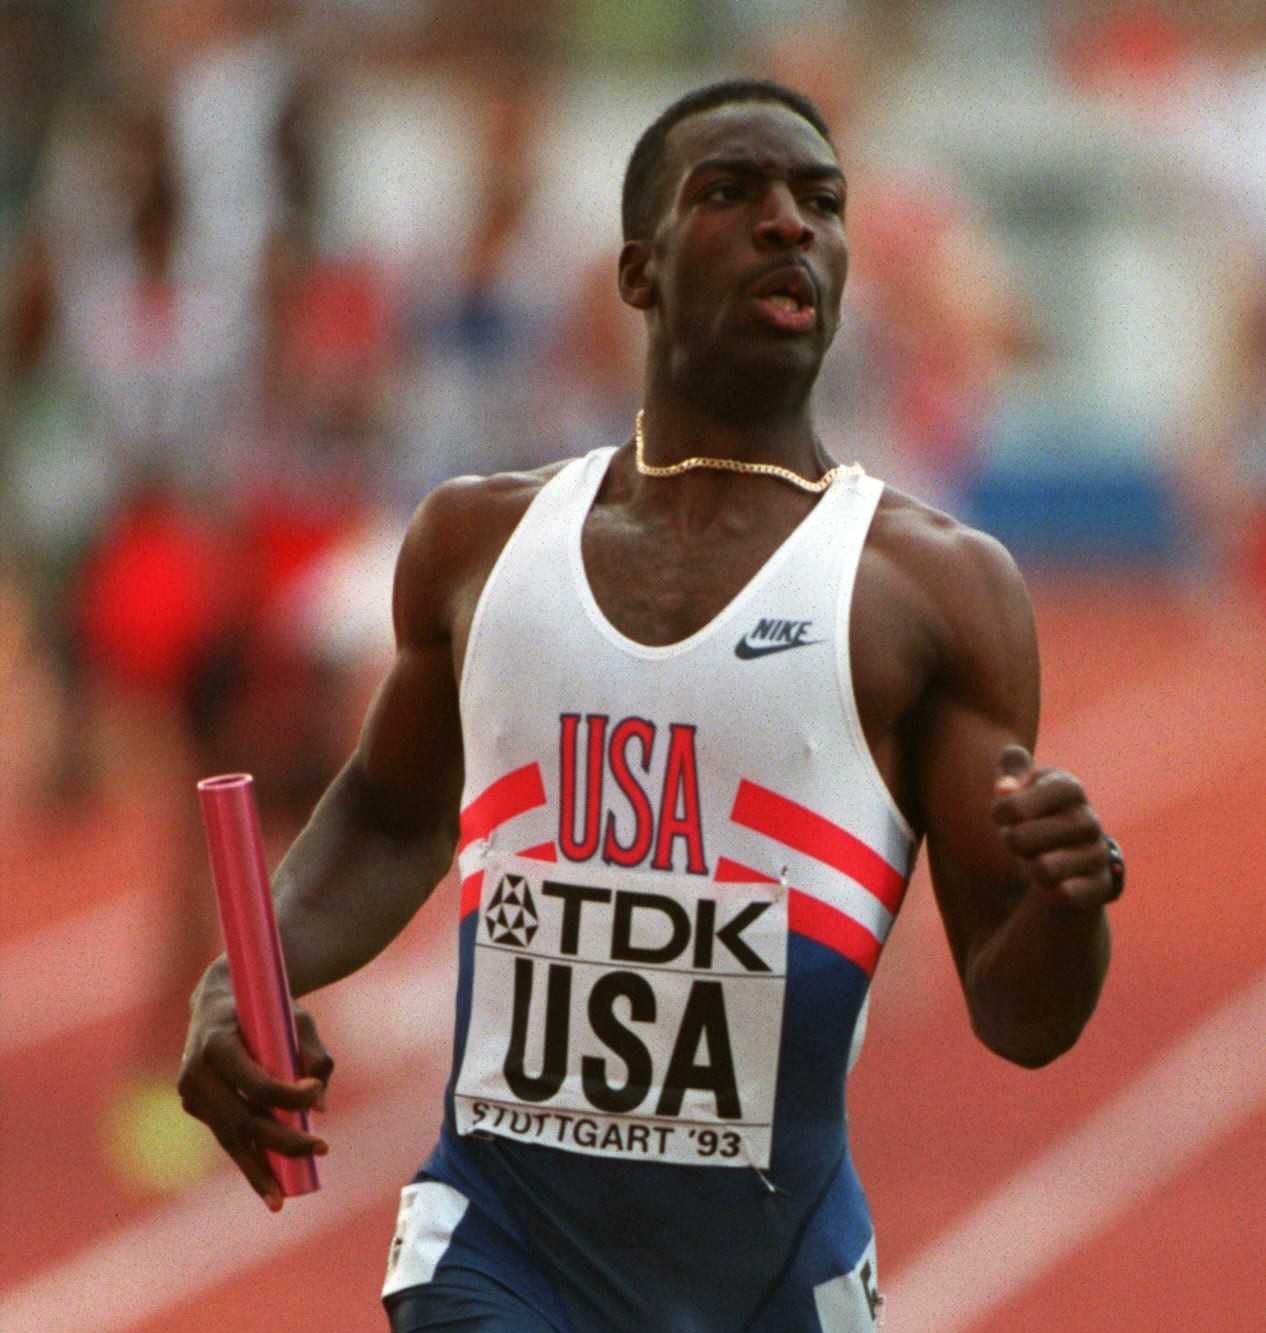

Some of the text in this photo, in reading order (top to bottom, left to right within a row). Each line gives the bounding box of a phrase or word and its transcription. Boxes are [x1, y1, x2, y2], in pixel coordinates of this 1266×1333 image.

[751, 618, 813, 641] NIKE
[558, 713, 709, 876] USA
[540, 880, 773, 973] TDK
[503, 958, 743, 1119] USA
[471, 1102, 742, 1158] STUTTGART '93
